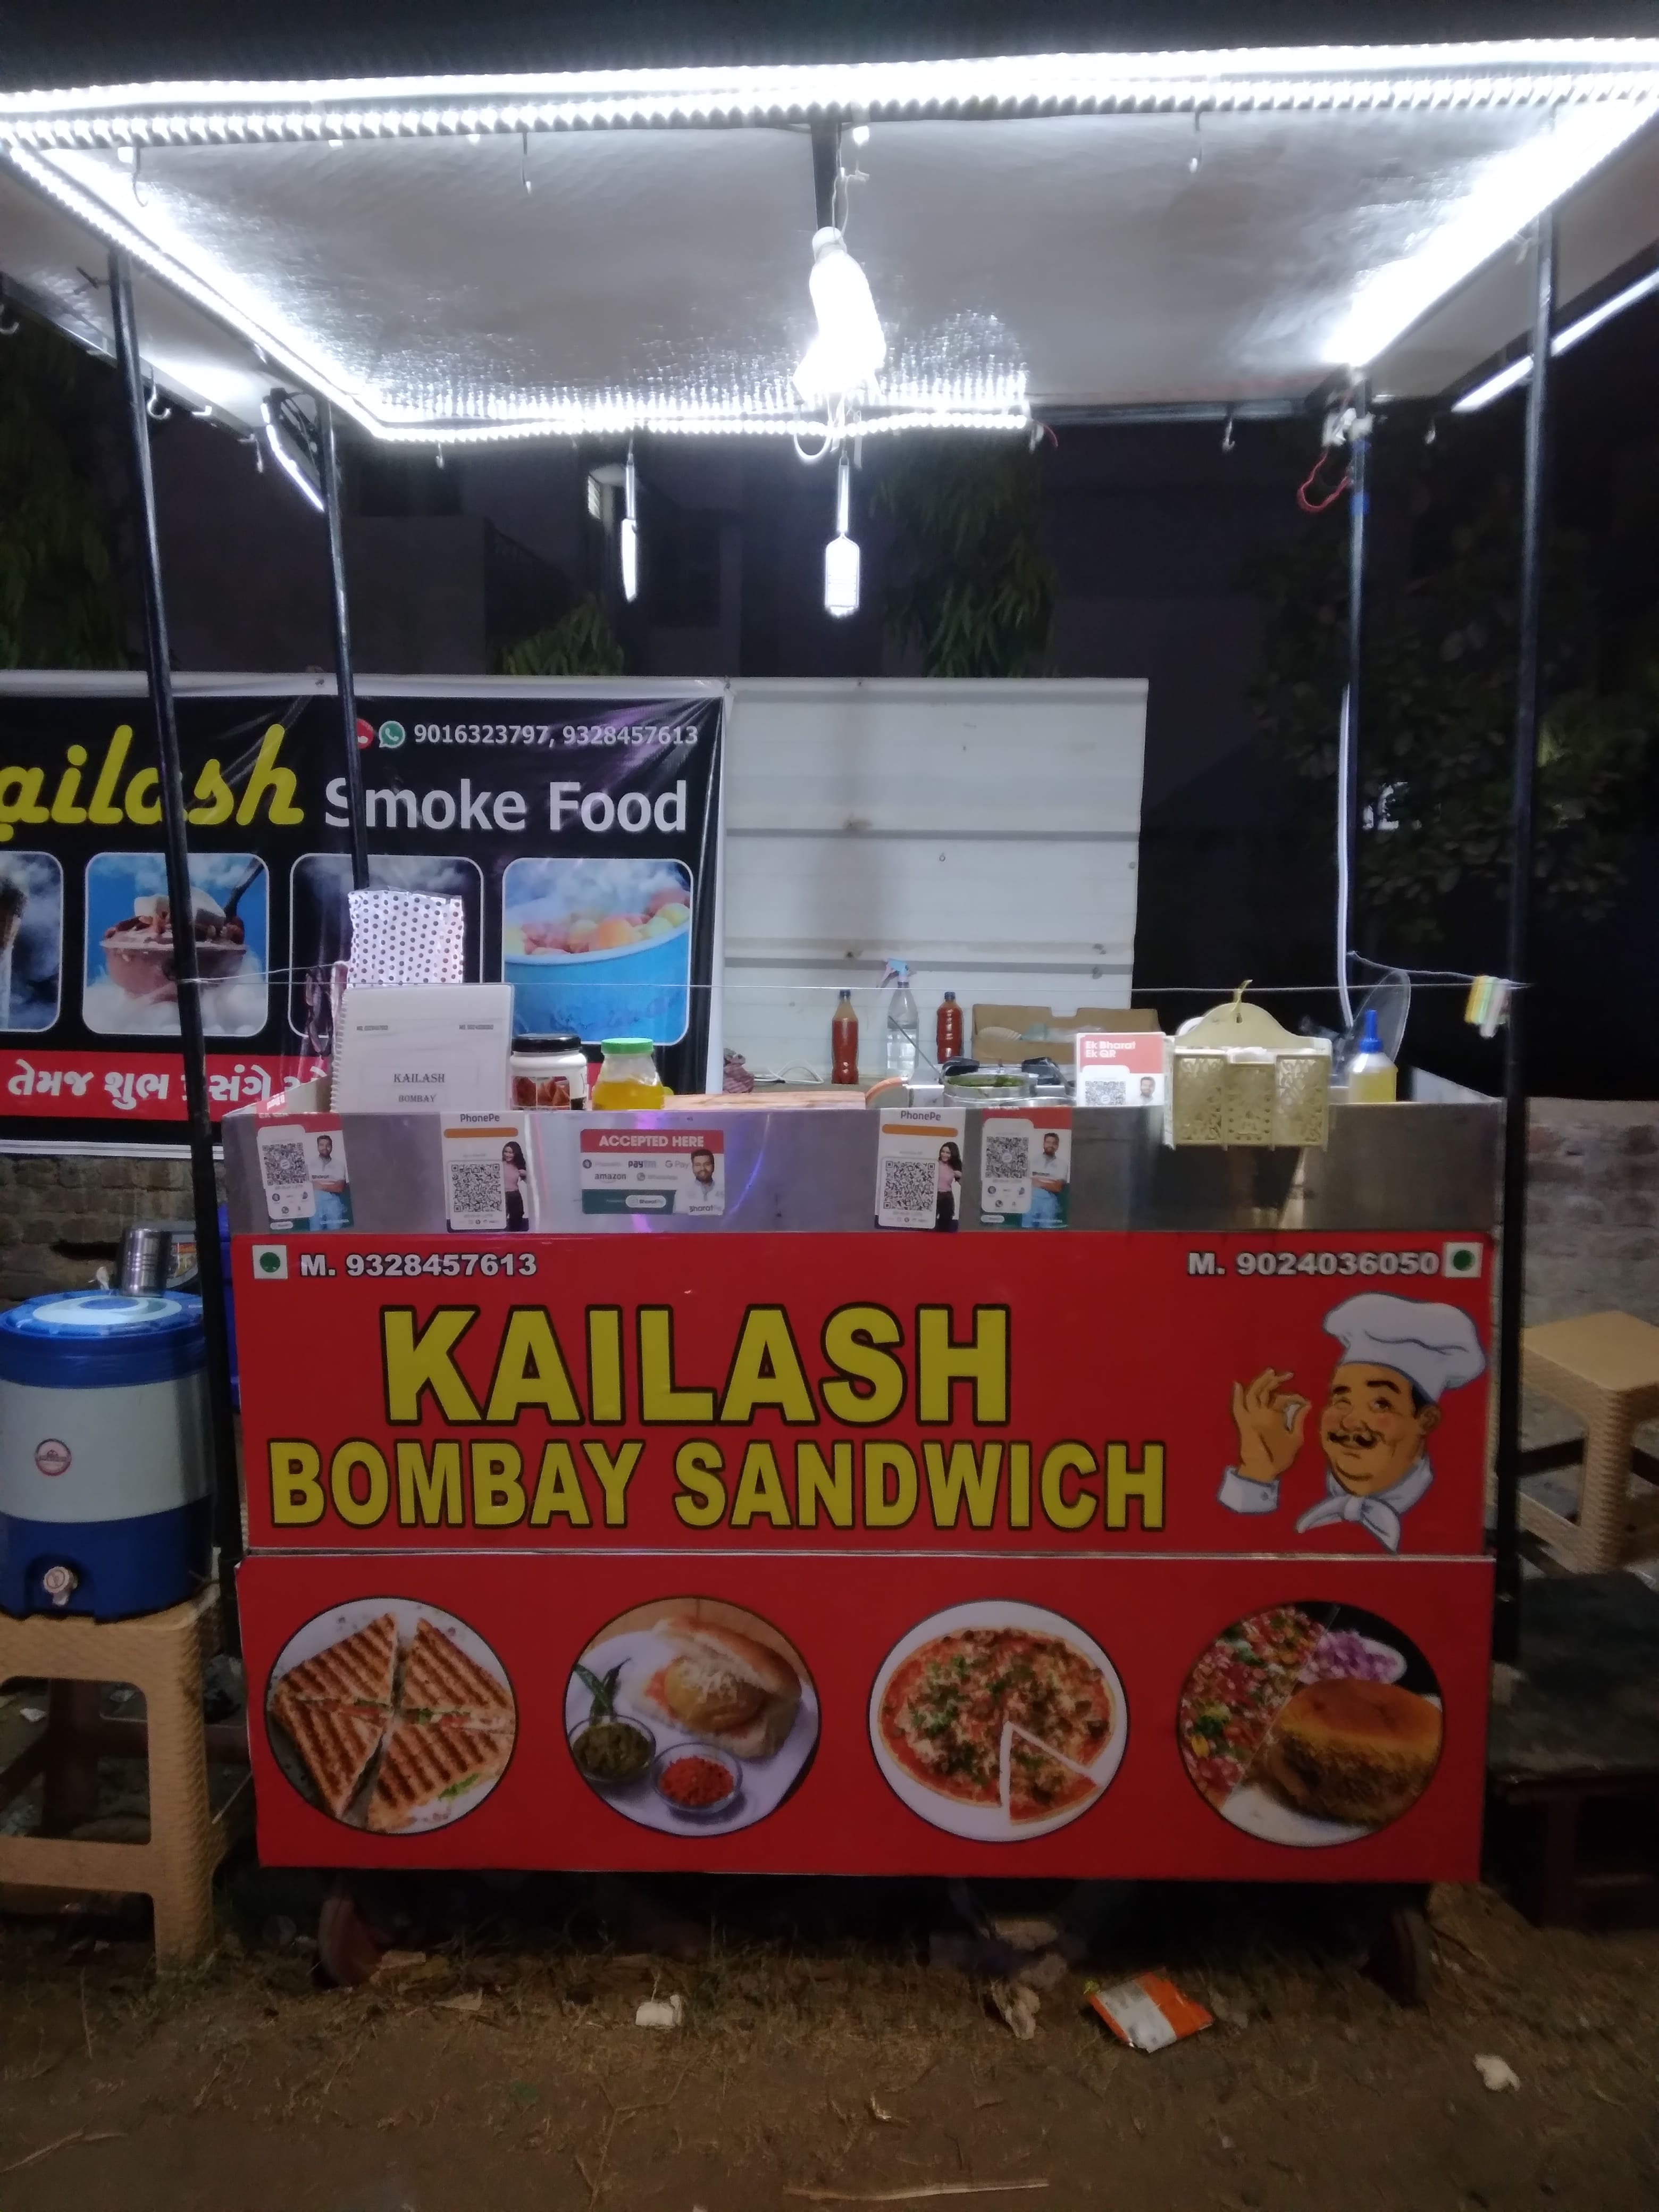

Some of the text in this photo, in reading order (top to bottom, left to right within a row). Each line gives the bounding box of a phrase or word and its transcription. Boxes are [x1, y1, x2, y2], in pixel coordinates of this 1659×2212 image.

[414, 724, 698, 748] 9016323797, 9328457613
[0, 724, 686, 842] ailash Smoke Food
[1085, 1041, 1136, 1050] Ek Bharat
[1099, 1049, 1117, 1058] QR
[393, 1073, 445, 1083] KAILASH
[8, 1059, 94, 1096] તેમજ
[104, 1071, 170, 1110] શુભ
[181, 1065, 271, 1101] સંગે
[398, 1094, 437, 1103] BOMBAY
[460, 1113, 500, 1122] PhonePe
[901, 1110, 941, 1121] PhonePe
[599, 1135, 704, 1147] ACCEPTED HERE
[675, 1161, 689, 1169] Pay
[300, 1253, 537, 1276] M. 9328457613
[1187, 1252, 1440, 1276] M. 9024036050
[380, 1304, 1011, 1427] KAILASH
[267, 1437, 1167, 1531] BOMBAY SANDWICH
